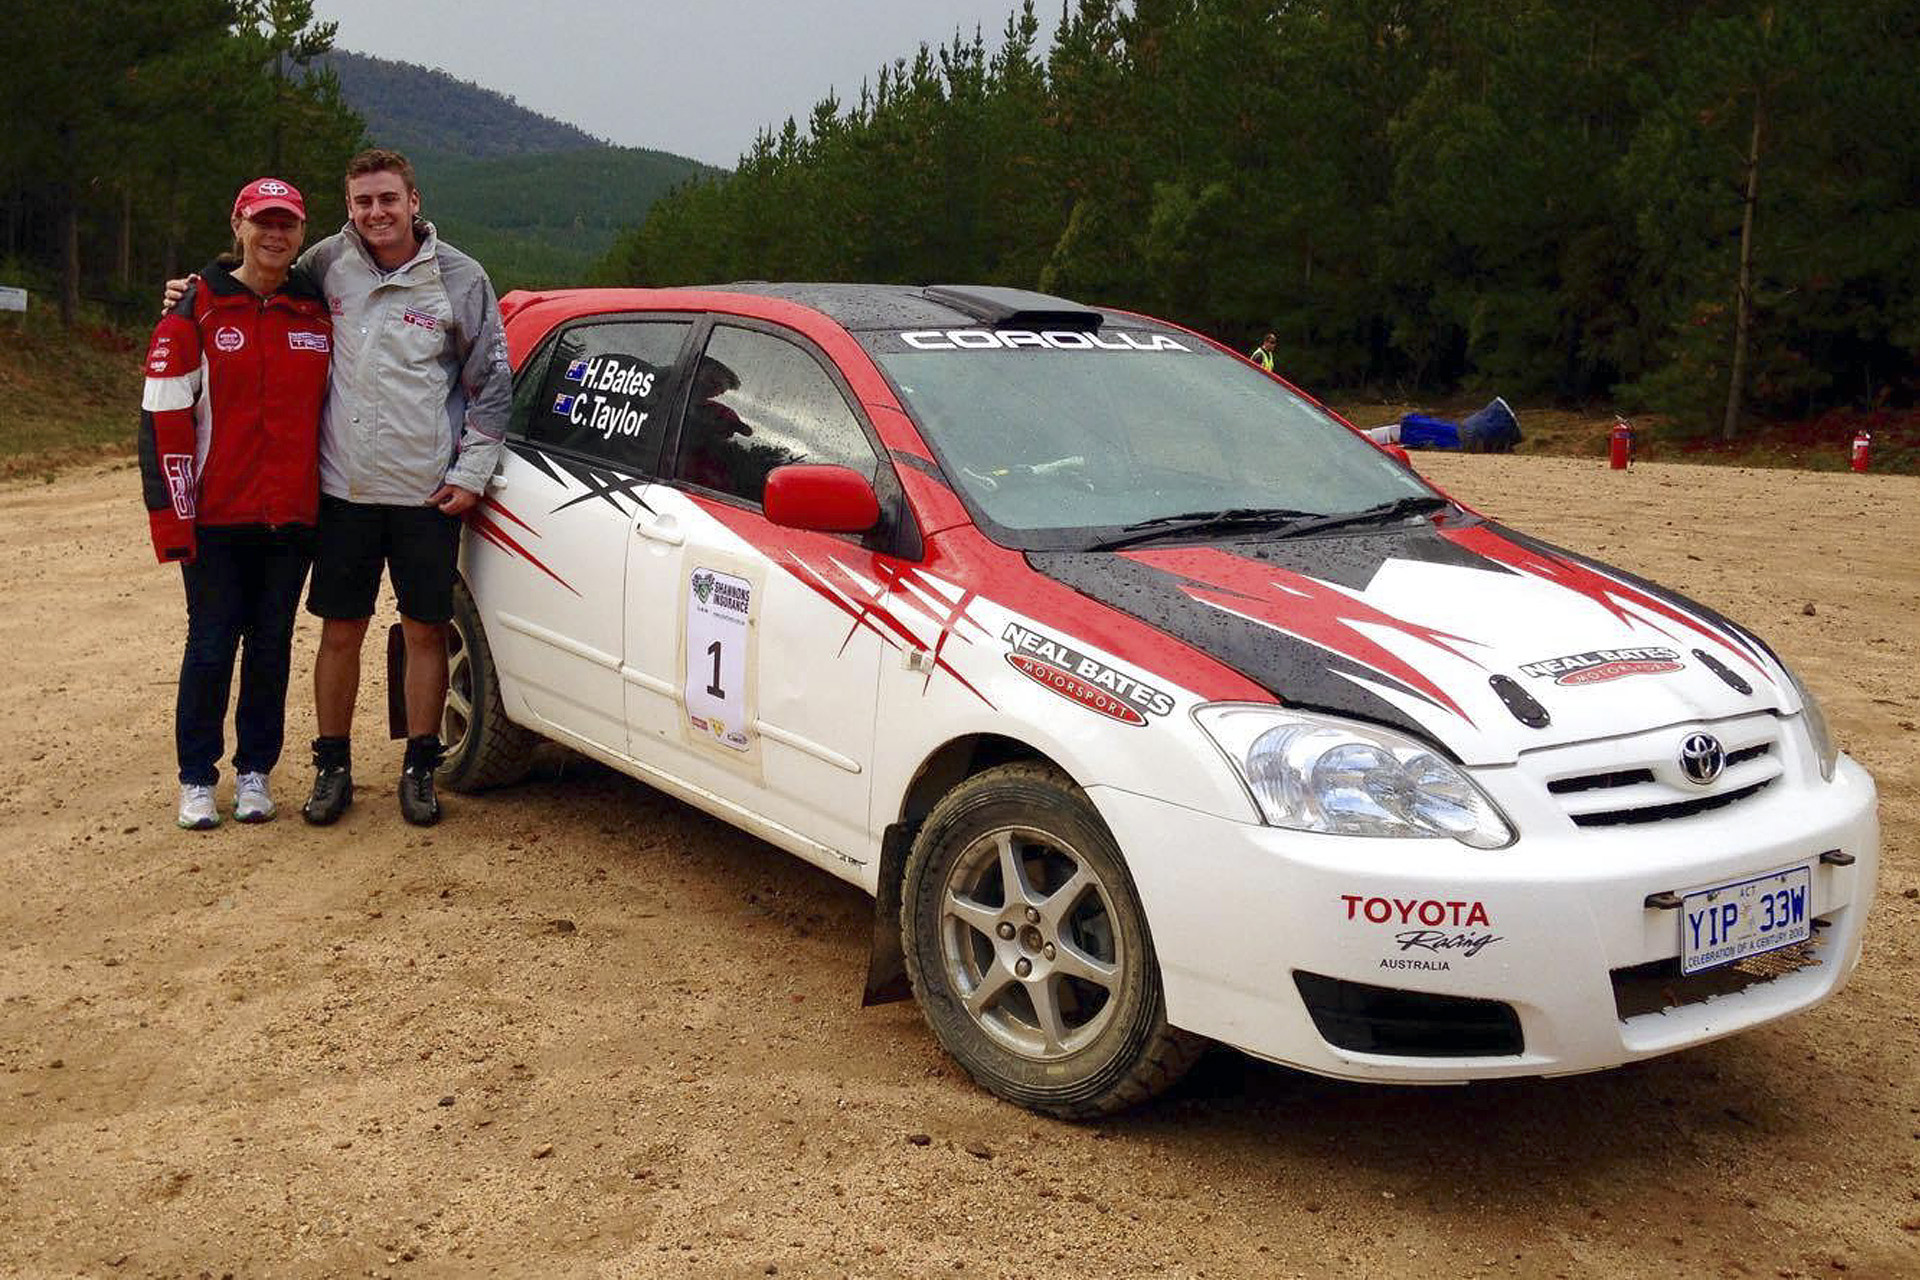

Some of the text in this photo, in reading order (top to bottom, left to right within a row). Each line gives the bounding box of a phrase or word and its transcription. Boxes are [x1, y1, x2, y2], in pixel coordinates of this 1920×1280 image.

[900, 330, 1193, 353] COROLLA
[580, 357, 655, 397] H.Bates
[570, 393, 649, 440] C.Taylor
[706, 640, 726, 700] 1
[1003, 624, 1174, 716] NEAL BATES
[1520, 647, 1679, 677] NEAL BATES
[1022, 662, 1128, 719] MOTORSPORT
[1341, 894, 1490, 927] TOYOTA
[1688, 885, 1806, 950] YIP 33W
[1395, 930, 1505, 958] Racing
[1687, 947, 1736, 968] CELEBRATION
[1379, 958, 1451, 971] AUSTRALIA
